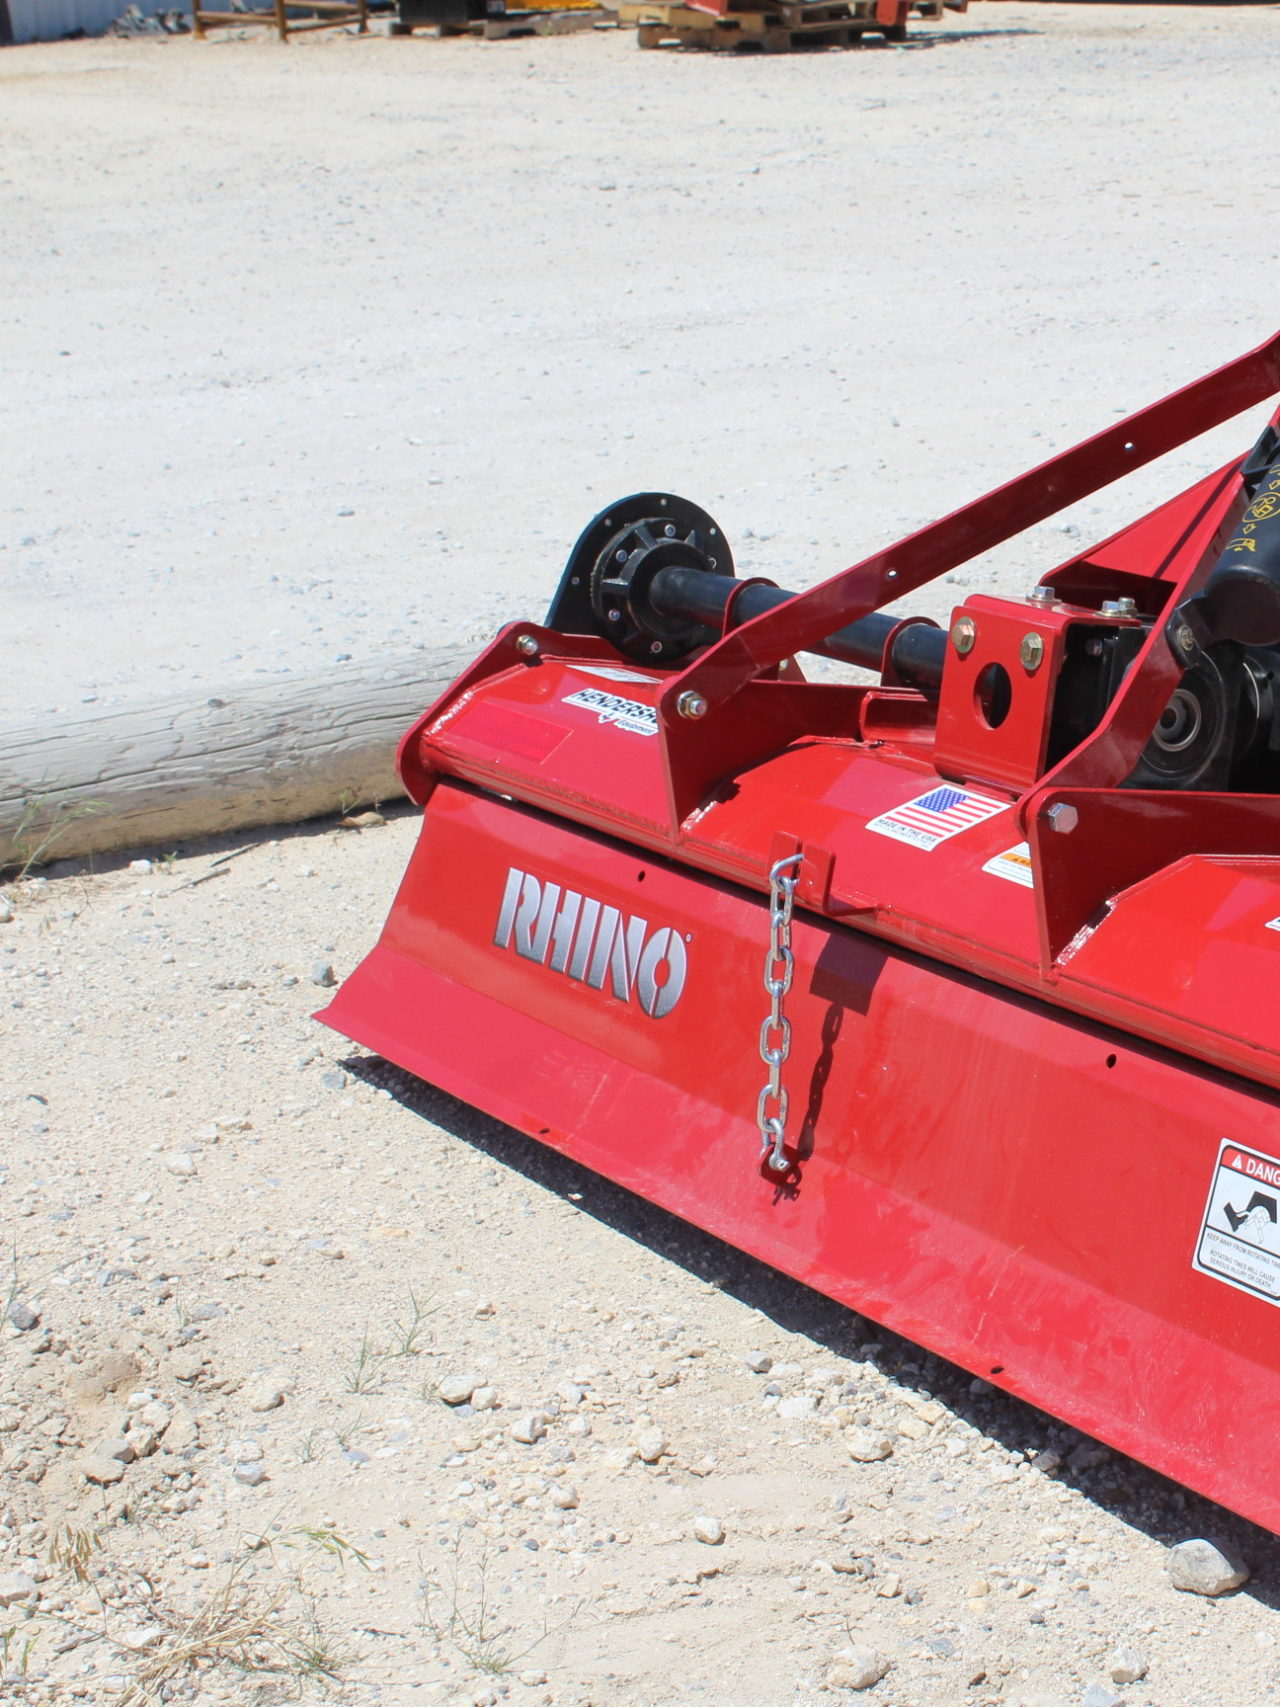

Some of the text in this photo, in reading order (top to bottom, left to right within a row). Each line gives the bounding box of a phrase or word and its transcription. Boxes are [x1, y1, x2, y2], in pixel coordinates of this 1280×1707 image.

[571, 690, 657, 723] HENDERSH
[493, 867, 687, 1019] RHINO
[1207, 1232, 1219, 1242] KEEP
[1233, 1242, 1246, 1253] FROM
[1247, 1249, 1270, 1264] ROTATING
[1210, 1249, 1232, 1263] ROTATING
[1259, 1271, 1275, 1282] CAUSE
